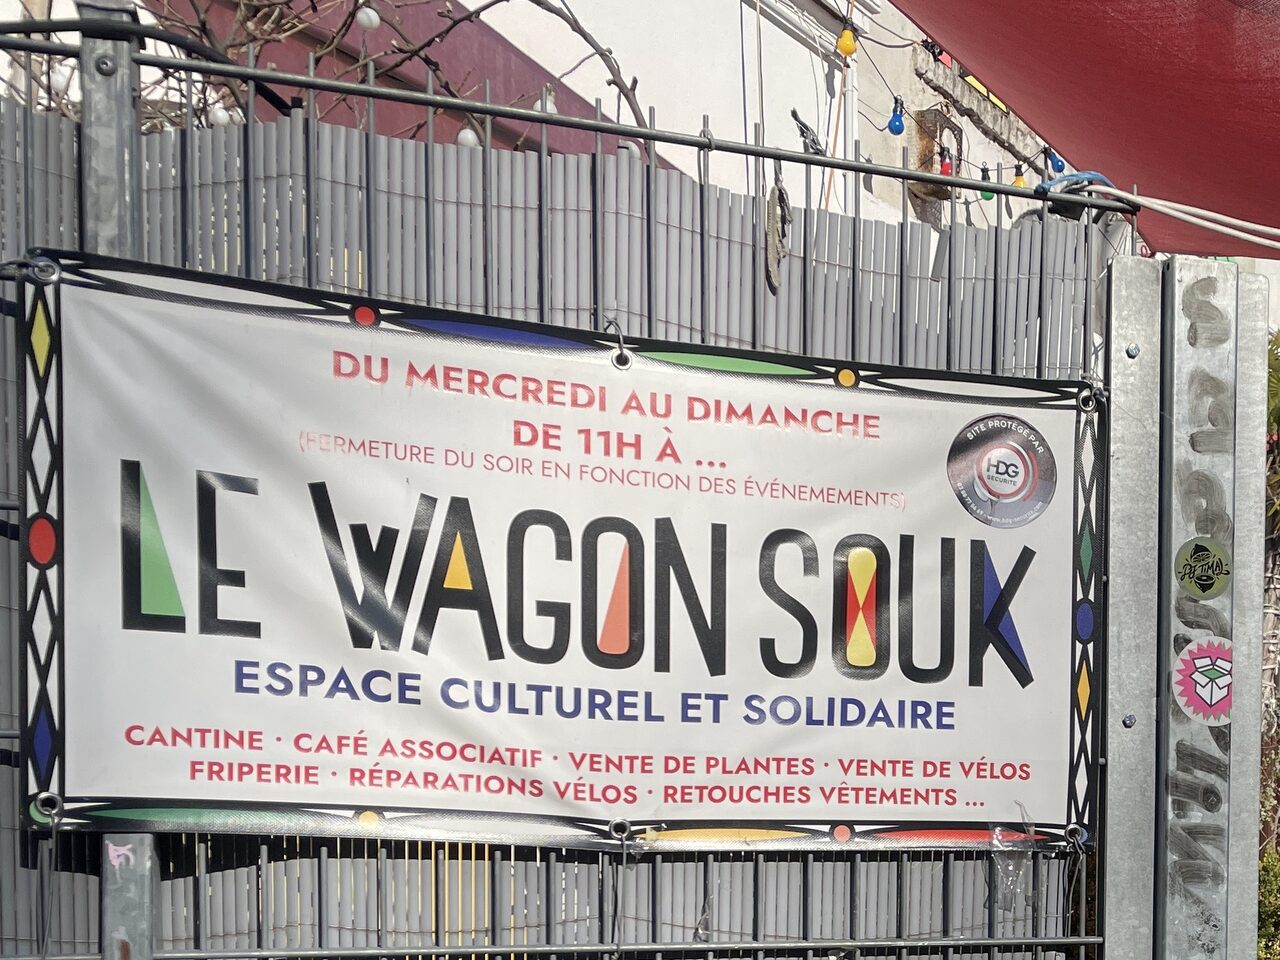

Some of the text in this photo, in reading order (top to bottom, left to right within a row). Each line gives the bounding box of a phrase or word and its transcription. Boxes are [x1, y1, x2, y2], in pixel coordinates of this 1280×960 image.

[333, 350, 881, 440] DU MERCREDI AU DIMANCHE
[513, 420, 561, 452] DE
[577, 428, 642, 461] 11H
[655, 426, 682, 464] À
[966, 420, 1044, 454] SITE PROTÉGÉ PAR
[299, 431, 906, 512] (FERMETURE DU SOIR EN FONCTION DES ÉVÉNEMEMENTS)
[987, 457, 1019, 478] HDG
[120, 459, 1037, 689] LE WAGON SOUK
[234, 659, 956, 731] ESPACE CULTUREL ET SOLIDAIRE
[124, 724, 1031, 781] CANTINE CAFÉ ASSOCIATIF VENTE DE PLANTES VENTE DE VÉLOS
[189, 760, 320, 785] FRIPERIE
[348, 762, 544, 798] RÉPARATIONS
[553, 775, 638, 804] VÉLOS
[663, 783, 811, 805] RETOUCHES
[820, 781, 957, 807] VÊTEMENTS
